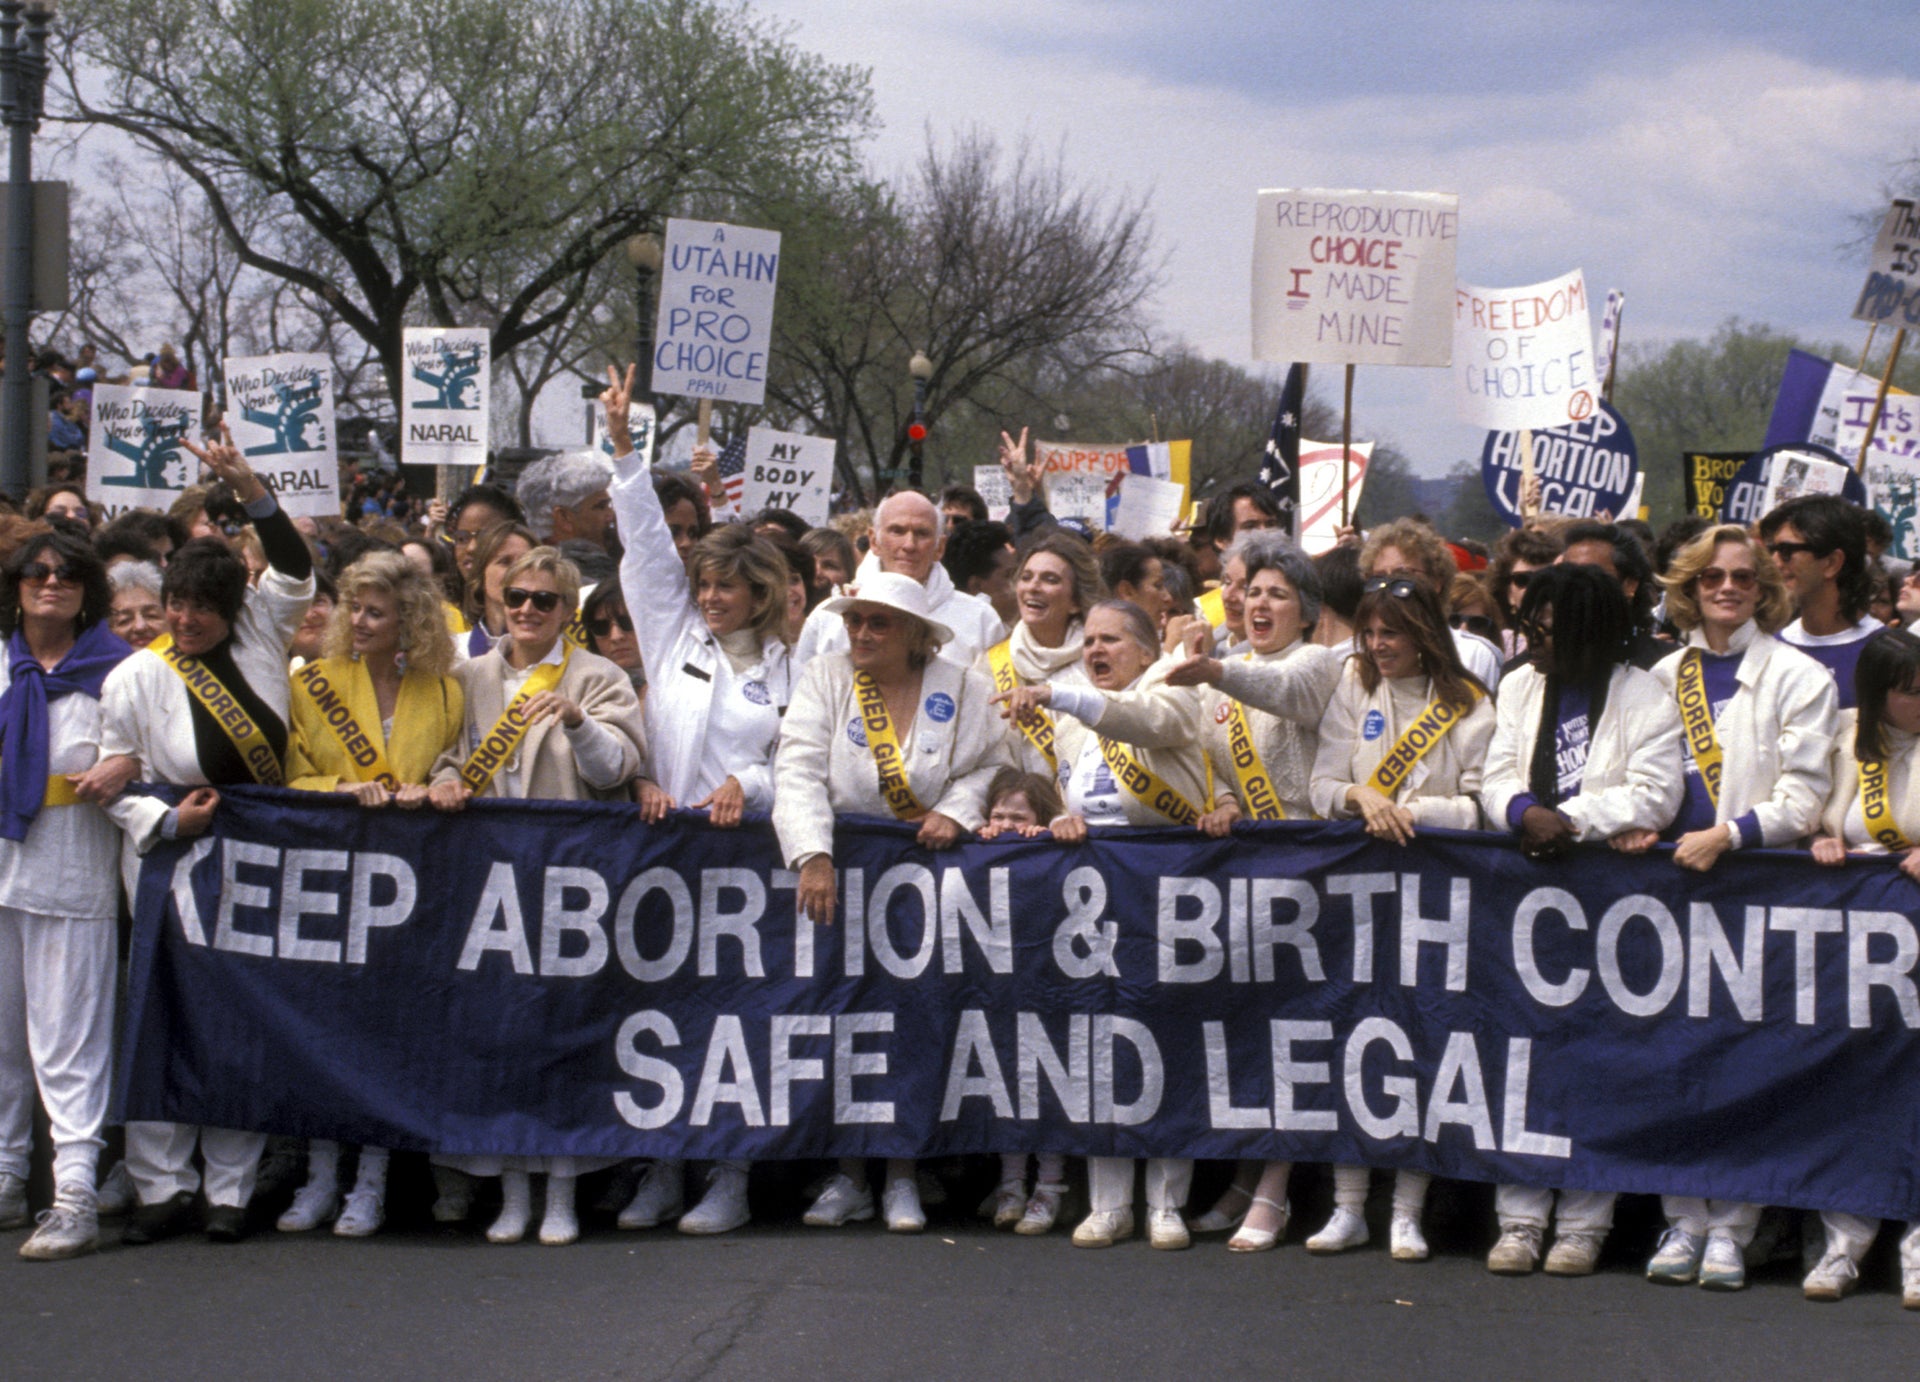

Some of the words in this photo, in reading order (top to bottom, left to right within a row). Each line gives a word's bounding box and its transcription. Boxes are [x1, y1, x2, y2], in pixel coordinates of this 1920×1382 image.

[713, 228, 725, 242] A
[1276, 201, 1458, 239] REPRODUCTIVE
[672, 244, 777, 283] UTAHN
[691, 285, 736, 309] FOR
[1287, 268, 1312, 298] I
[1326, 272, 1408, 304] MADE
[1456, 278, 1585, 330] FREEDOM
[669, 308, 750, 343] PRO
[1317, 312, 1403, 346] MINE
[656, 341, 764, 381] CHOICE
[1487, 335, 1536, 361] OF
[229, 374, 261, 395] Who
[687, 379, 727, 395] PPAU
[1466, 351, 1588, 398] CHOICE
[97, 400, 129, 422] Who
[1543, 408, 1617, 443] EP
[1844, 396, 1912, 432] It's
[410, 424, 479, 442] NARAL
[770, 442, 802, 460] MY
[268, 469, 329, 491] ARAL
[754, 465, 815, 487] BODY
[765, 490, 801, 509] MY
[1496, 471, 1597, 518] LGAL
[163, 646, 253, 739] HONORED
[248, 744, 284, 785] GUE
[299, 663, 378, 767] HONORED
[855, 669, 889, 733] ORED
[874, 742, 918, 813] GUEST
[1377, 701, 1458, 787] ONORED
[1228, 706, 1254, 769] ORED
[1245, 776, 1279, 820] GUE
[1100, 738, 1152, 795] NORED
[1154, 789, 1199, 826] GUE
[1862, 760, 1885, 819] ORED
[457, 861, 1012, 980] ABORTION
[1053, 866, 1120, 980] &
[1157, 871, 1472, 992] BIRTH
[1512, 886, 1920, 1029] CONTR
[612, 1008, 897, 1131] SAFE
[939, 1009, 1165, 1127] AND
[1203, 1015, 1572, 1159] LEGAL
